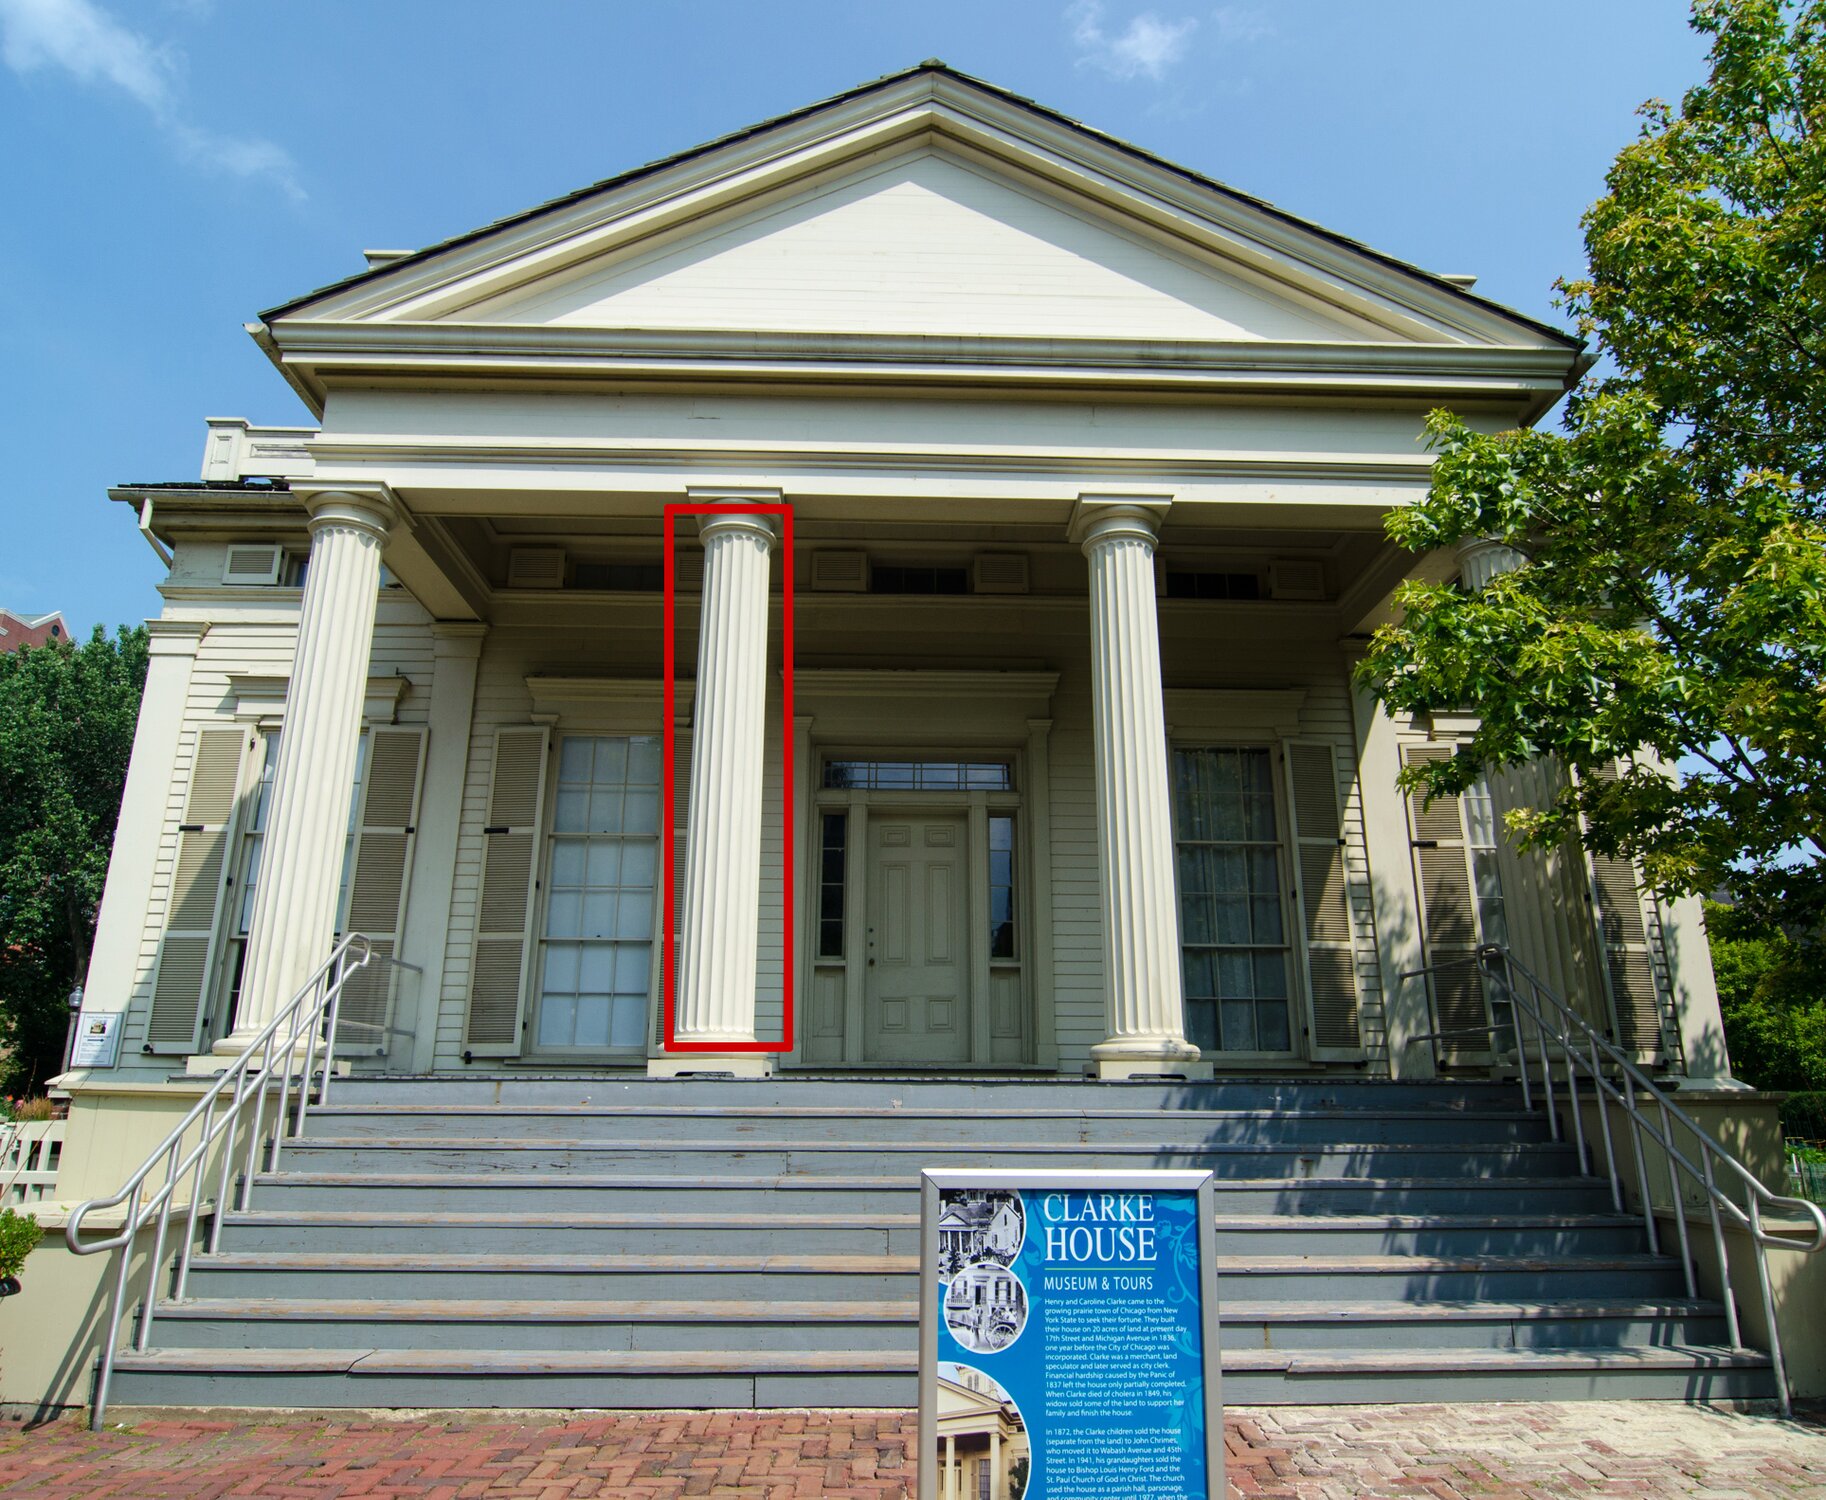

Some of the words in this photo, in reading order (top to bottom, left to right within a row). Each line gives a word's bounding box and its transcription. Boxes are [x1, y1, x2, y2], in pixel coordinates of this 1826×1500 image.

[1044, 1194, 1154, 1222] CLARKE
[1044, 1227, 1157, 1261] HOUSE
[1044, 1276, 1097, 1290] MUSEUM
[1102, 1276, 1109, 1290] &
[1114, 1276, 1153, 1290] TOURS
[1045, 1298, 1064, 1307] Henry
[1045, 1307, 1072, 1316] growing
[1073, 1307, 1093, 1316] prairie
[1120, 1307, 1146, 1316] Chicago
[1144, 1316, 1159, 1325] They
[1061, 1325, 1081, 1333] house
[1150, 1325, 1174, 1334] present
[1175, 1325, 1187, 1334] day
[1081, 1334, 1094, 1342] and
[1095, 1334, 1125, 1343] Michigan
[1059, 1345, 1073, 1353] year
[1108, 1344, 1121, 1352] City
[1130, 1343, 1156, 1352] Chicago
[1045, 1362, 1079, 1371] speculator
[1140, 1362, 1152, 1371] city
[1075, 1371, 1104, 1380] hardship
[1128, 1371, 1137, 1380] by
[1063, 1380, 1074, 1388] left
[1108, 1380, 1122, 1389] only
[1123, 1380, 1149, 1389] partially
[1147, 1399, 1172, 1407] support
[1173, 1398, 1184, 1406] her
[1046, 1409, 1066, 1418] family
[1085, 1427, 1105, 1435] Clarke
[1100, 1446, 1126, 1454] Wabash
[1068, 1456, 1075, 1464] In
[1106, 1456, 1154, 1465] grandaughters
[1155, 1455, 1169, 1463] sold
[1076, 1466, 1099, 1474] Bishop
[1118, 1465, 1138, 1474] Henry
[1169, 1464, 1180, 1472] the
[1111, 1484, 1132, 1493] parish
